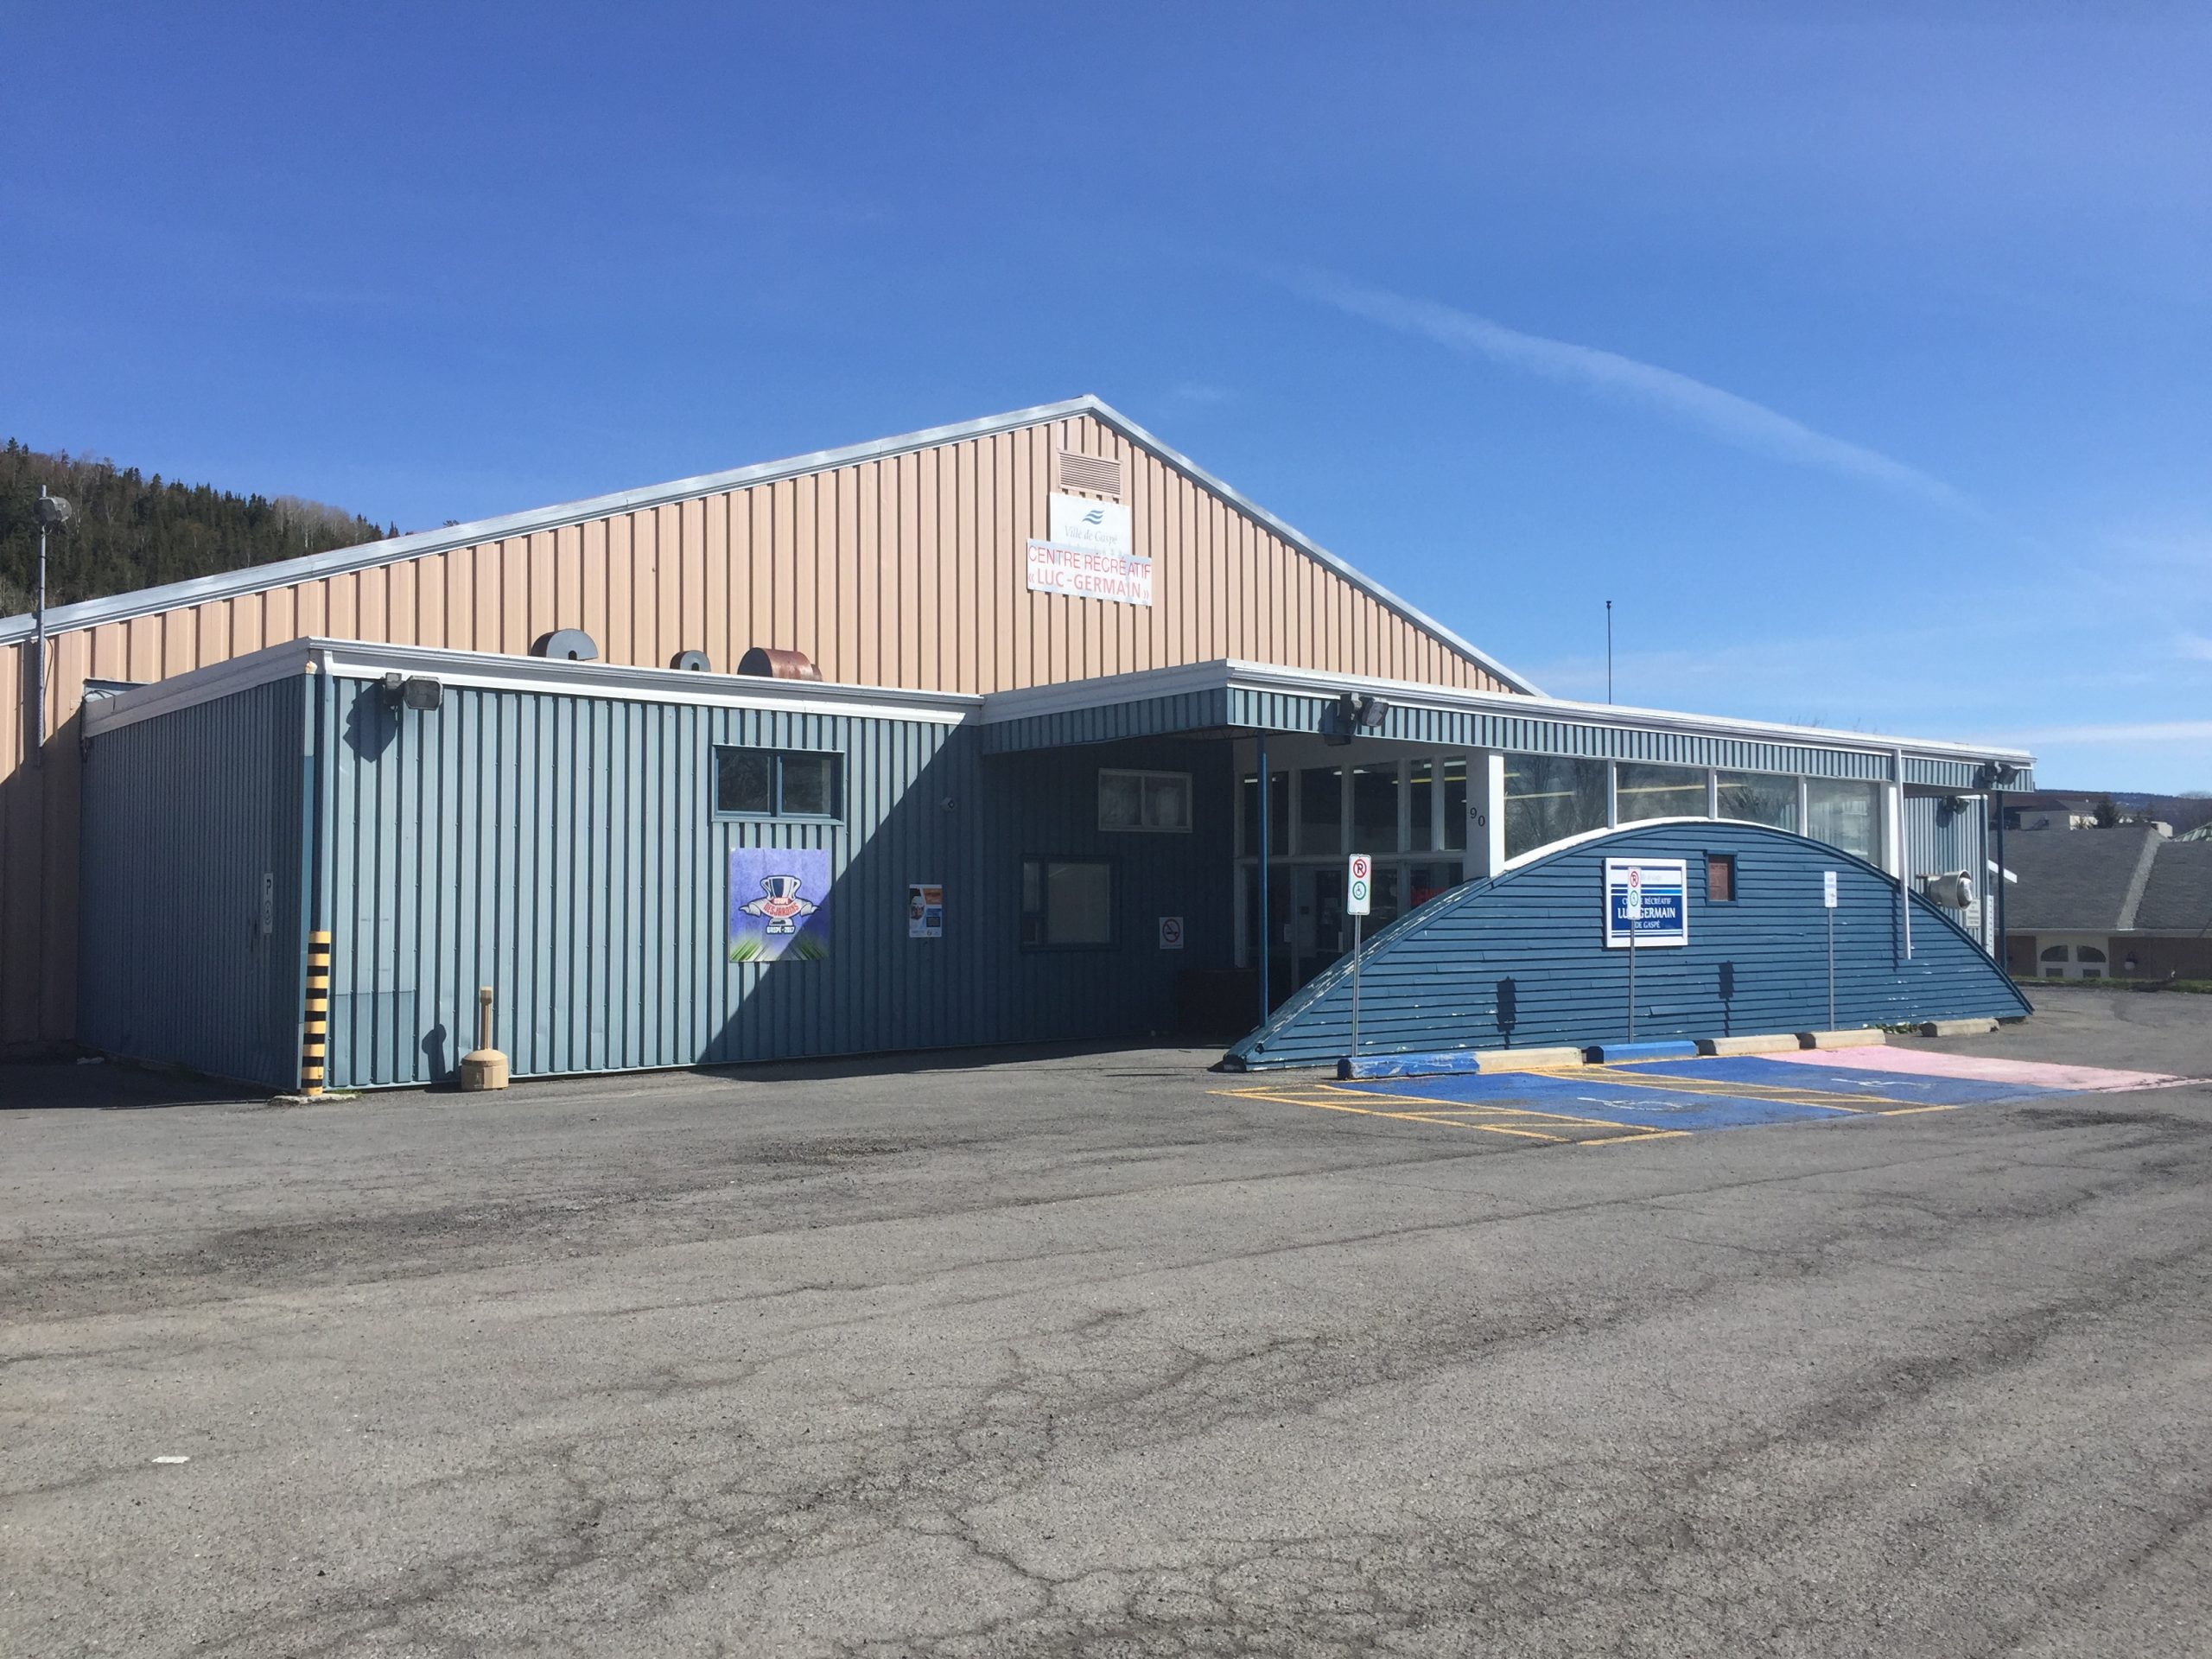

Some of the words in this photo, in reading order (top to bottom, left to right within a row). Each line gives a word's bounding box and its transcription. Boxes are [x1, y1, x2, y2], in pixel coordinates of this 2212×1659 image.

[1065, 525, 1082, 539] Ville
[1084, 529, 1093, 540] de
[1028, 545, 1081, 569] CENTRE
[1084, 552, 1151, 580] RÉCRÉATIF
[1470, 807, 1485, 827] 90
[763, 902, 799, 916] DESJARDINS
[1618, 907, 1675, 918] LUGERMAIN
[1643, 920, 1661, 929] GASPÉ
